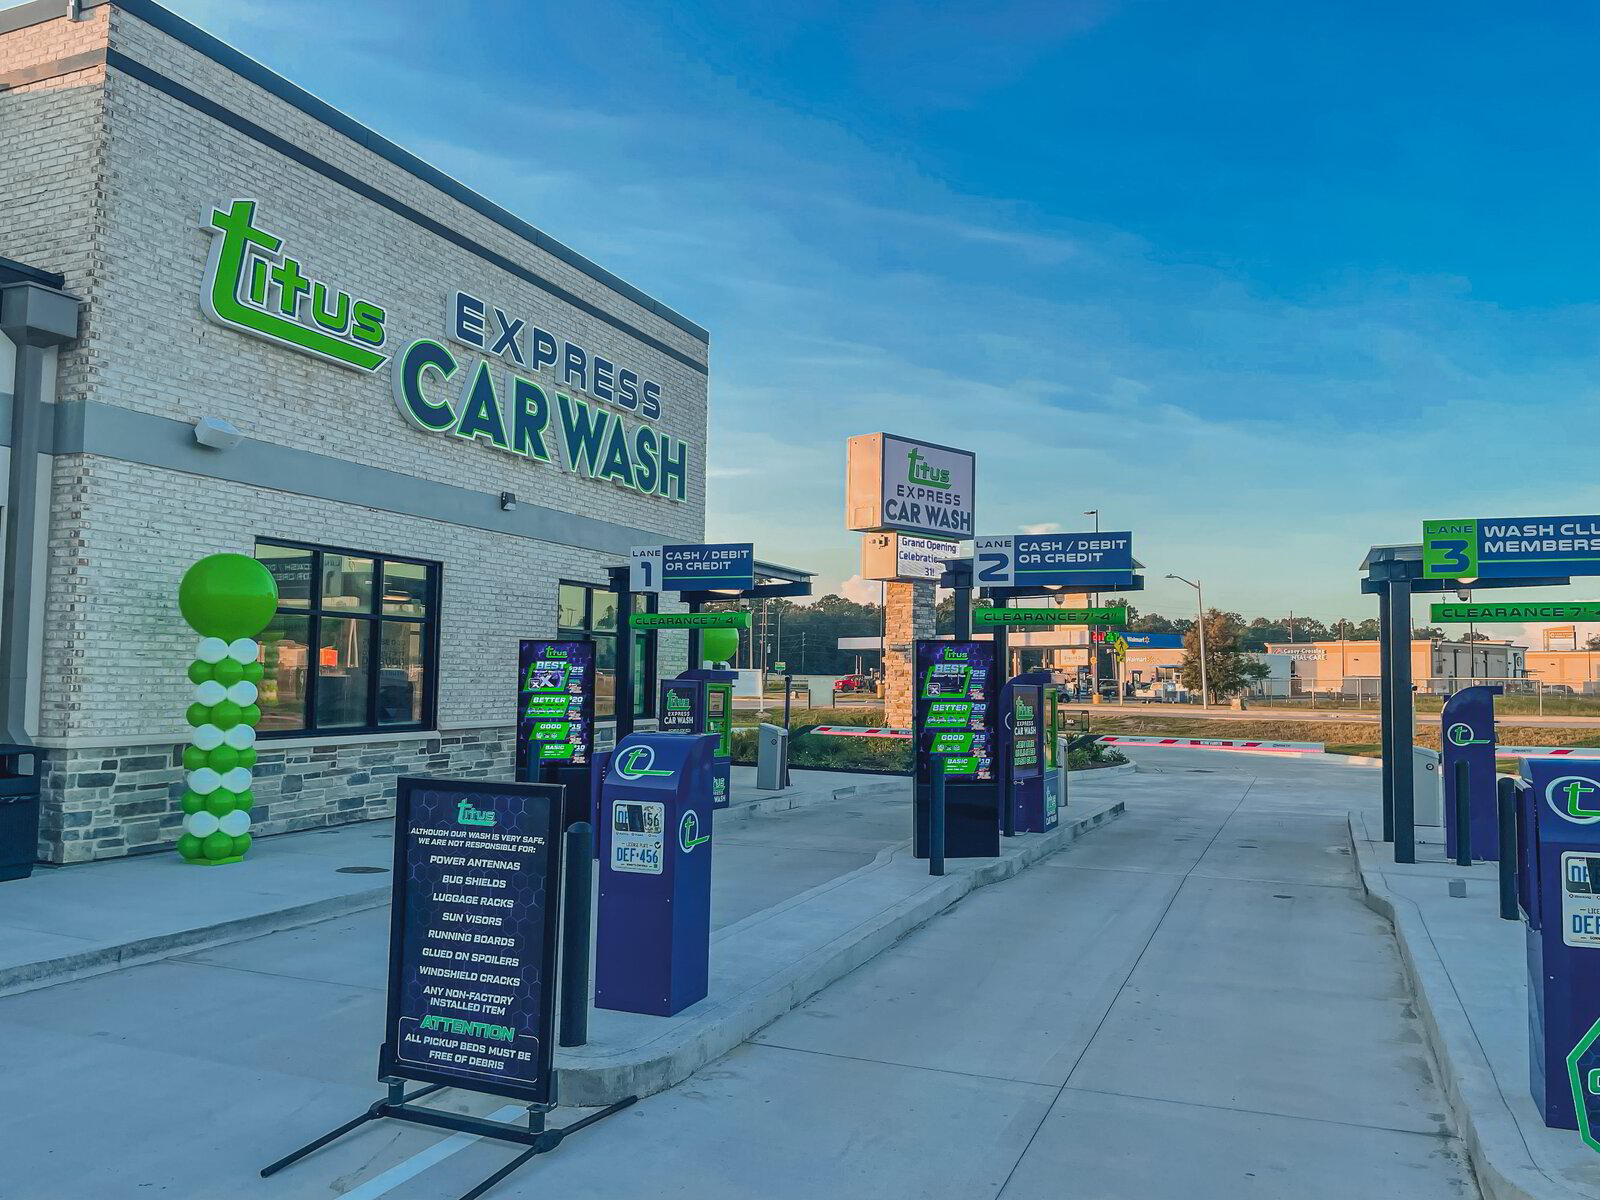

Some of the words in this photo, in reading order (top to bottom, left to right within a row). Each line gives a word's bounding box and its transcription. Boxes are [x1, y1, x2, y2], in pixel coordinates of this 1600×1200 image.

[211, 199, 388, 372] titus
[453, 290, 662, 420] EXPRESS
[399, 337, 552, 464] CAR
[555, 390, 688, 502] WASH
[908, 447, 952, 490] titus
[897, 484, 960, 507] EXPRESS
[885, 499, 921, 524] CAR
[925, 505, 970, 532] WASH
[1426, 526, 1473, 534] LANE
[1484, 524, 1554, 538] WASH
[902, 538, 925, 548] Grand
[926, 541, 957, 554] Opening
[976, 541, 1012, 549] LANE
[1019, 541, 1062, 552] CASH
[1066, 541, 1074, 552] /
[1078, 540, 1126, 550] DEBIT
[1484, 539, 1600, 553] MEMBERS
[633, 550, 660, 558] LANE
[665, 551, 700, 560] CASH
[703, 551, 709, 561] /
[712, 550, 750, 559] DEBIT
[1019, 554, 1040, 564] OR
[1044, 552, 1103, 564] CREDIT
[1430, 539, 1471, 573] 3
[665, 563, 683, 571] OR
[685, 561, 732, 570] CREDIT
[978, 552, 1009, 582] 2
[641, 562, 652, 587] 1
[635, 617, 708, 625] CLEARANCE
[984, 613, 1076, 621] CLEARANCE
[1442, 608, 1564, 618] CLEARANCE
[546, 646, 568, 658] titus
[944, 647, 968, 660] titus
[536, 661, 567, 670] BEST
[935, 664, 968, 674] BEST
[970, 670, 986, 678] $25
[664, 716, 677, 725] CAR
[677, 716, 694, 724] WASH
[1014, 727, 1024, 736] CAR
[1024, 726, 1036, 736] WASH
[410, 828, 449, 837] ALTHOUGH
[451, 830, 466, 838] OUR
[468, 831, 491, 840] WASH
[492, 833, 500, 841] IS
[501, 834, 522, 842] VERY
[522, 836, 545, 846] SAFE,
[431, 838, 447, 846] ARE
[465, 841, 517, 852] RESPONSIBLE
[518, 846, 536, 854] FOR:
[430, 855, 466, 866] POWER
[467, 858, 520, 871] ANTENNAS
[442, 874, 464, 884] BUG
[465, 877, 506, 888] SHIELDS
[433, 892, 479, 905] LUGGAGE
[480, 897, 514, 908] RACKS
[442, 912, 464, 923] SUN
[466, 914, 502, 926] VISORS
[428, 930, 472, 942] RUNNING
[474, 934, 515, 947] BOARDS
[422, 947, 453, 959] GLUED
[455, 952, 470, 961] ON
[471, 954, 520, 967] SPOILERS
[419, 965, 478, 982] WINDSHIELD
[480, 973, 521, 987] CRACKS
[423, 986, 444, 996] ANY
[445, 988, 514, 1006] NON-FACTORY
[430, 997, 480, 1012] INSTALLED
[482, 1004, 506, 1016] ITEM
[420, 1014, 516, 1042] ATTENTION
[405, 1033, 422, 1044] ALL
[423, 1036, 459, 1049] PICKUP
[460, 1042, 486, 1054] BEDS
[488, 1046, 516, 1058] MUST
[517, 1052, 532, 1061] BE
[429, 1050, 453, 1061] FREE
[454, 1054, 468, 1063] OF
[468, 1056, 505, 1070] DEBRIS
